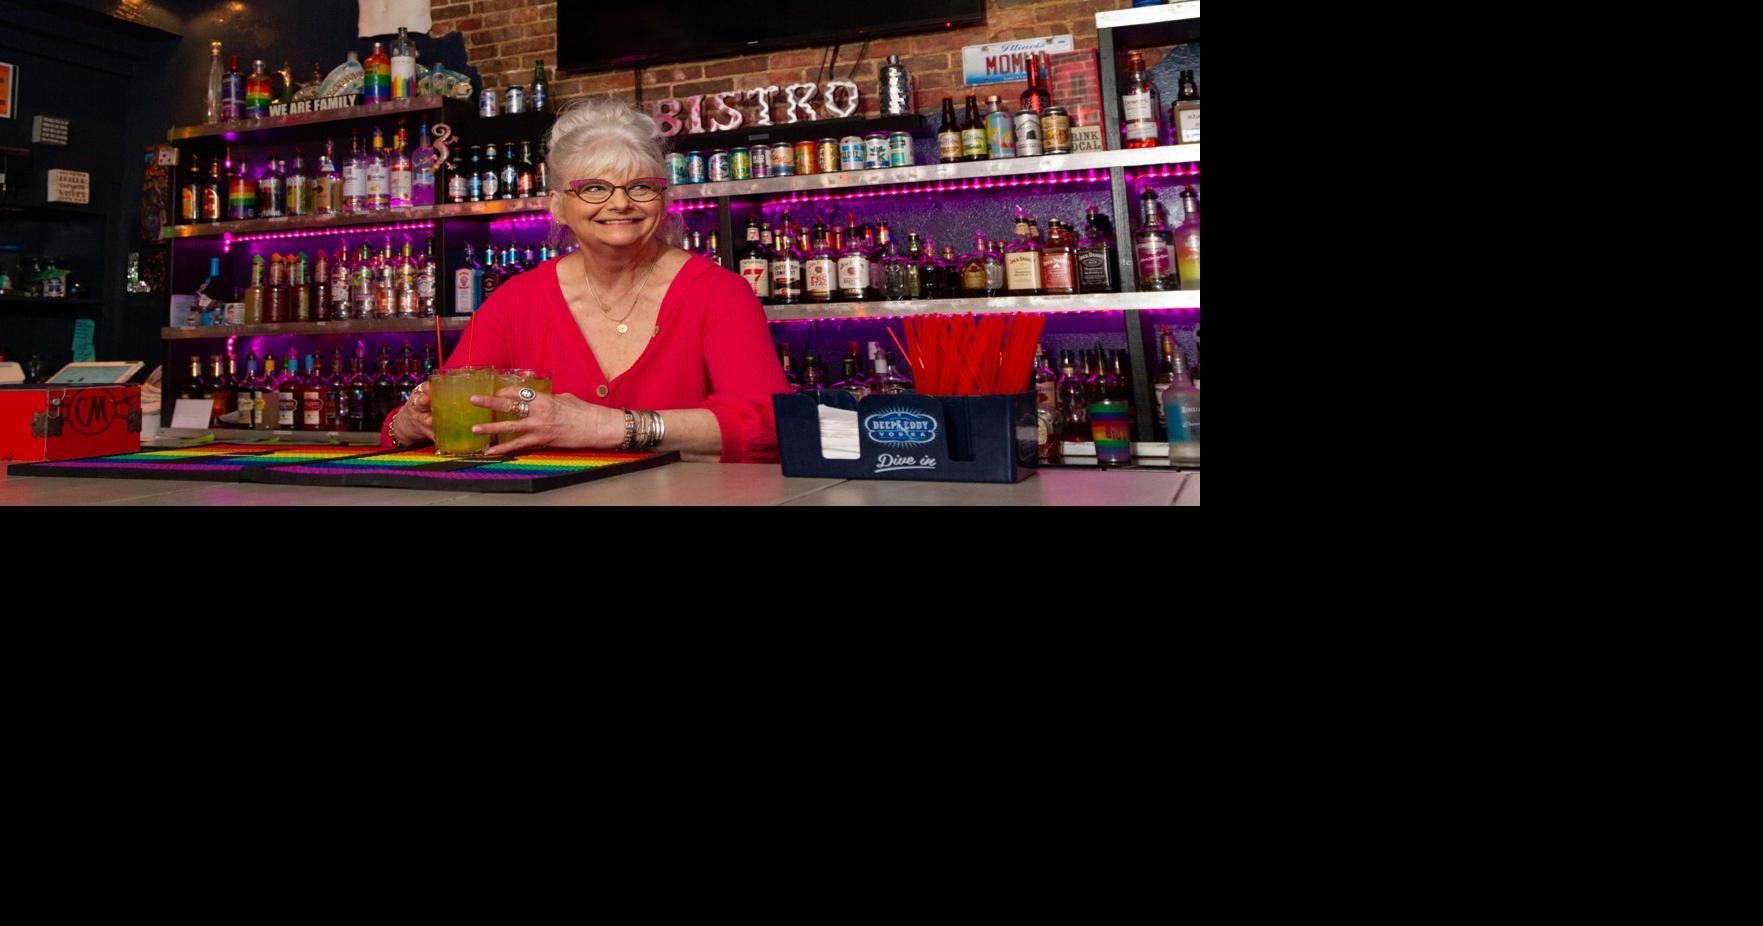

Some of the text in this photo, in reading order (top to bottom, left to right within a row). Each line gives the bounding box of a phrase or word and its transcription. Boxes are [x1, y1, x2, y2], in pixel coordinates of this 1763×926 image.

[1001, 42, 1045, 52] Illinois
[269, 95, 356, 117] WE ARE FAMILY
[652, 79, 859, 136] BISTRO
[1072, 131, 1099, 141] RINK
[1072, 141, 1097, 151] OCAL
[743, 268, 765, 296] 7
[75, 395, 109, 428] CM
[873, 421, 928, 430] DEEP EDDY
[876, 453, 937, 468] Dive in
